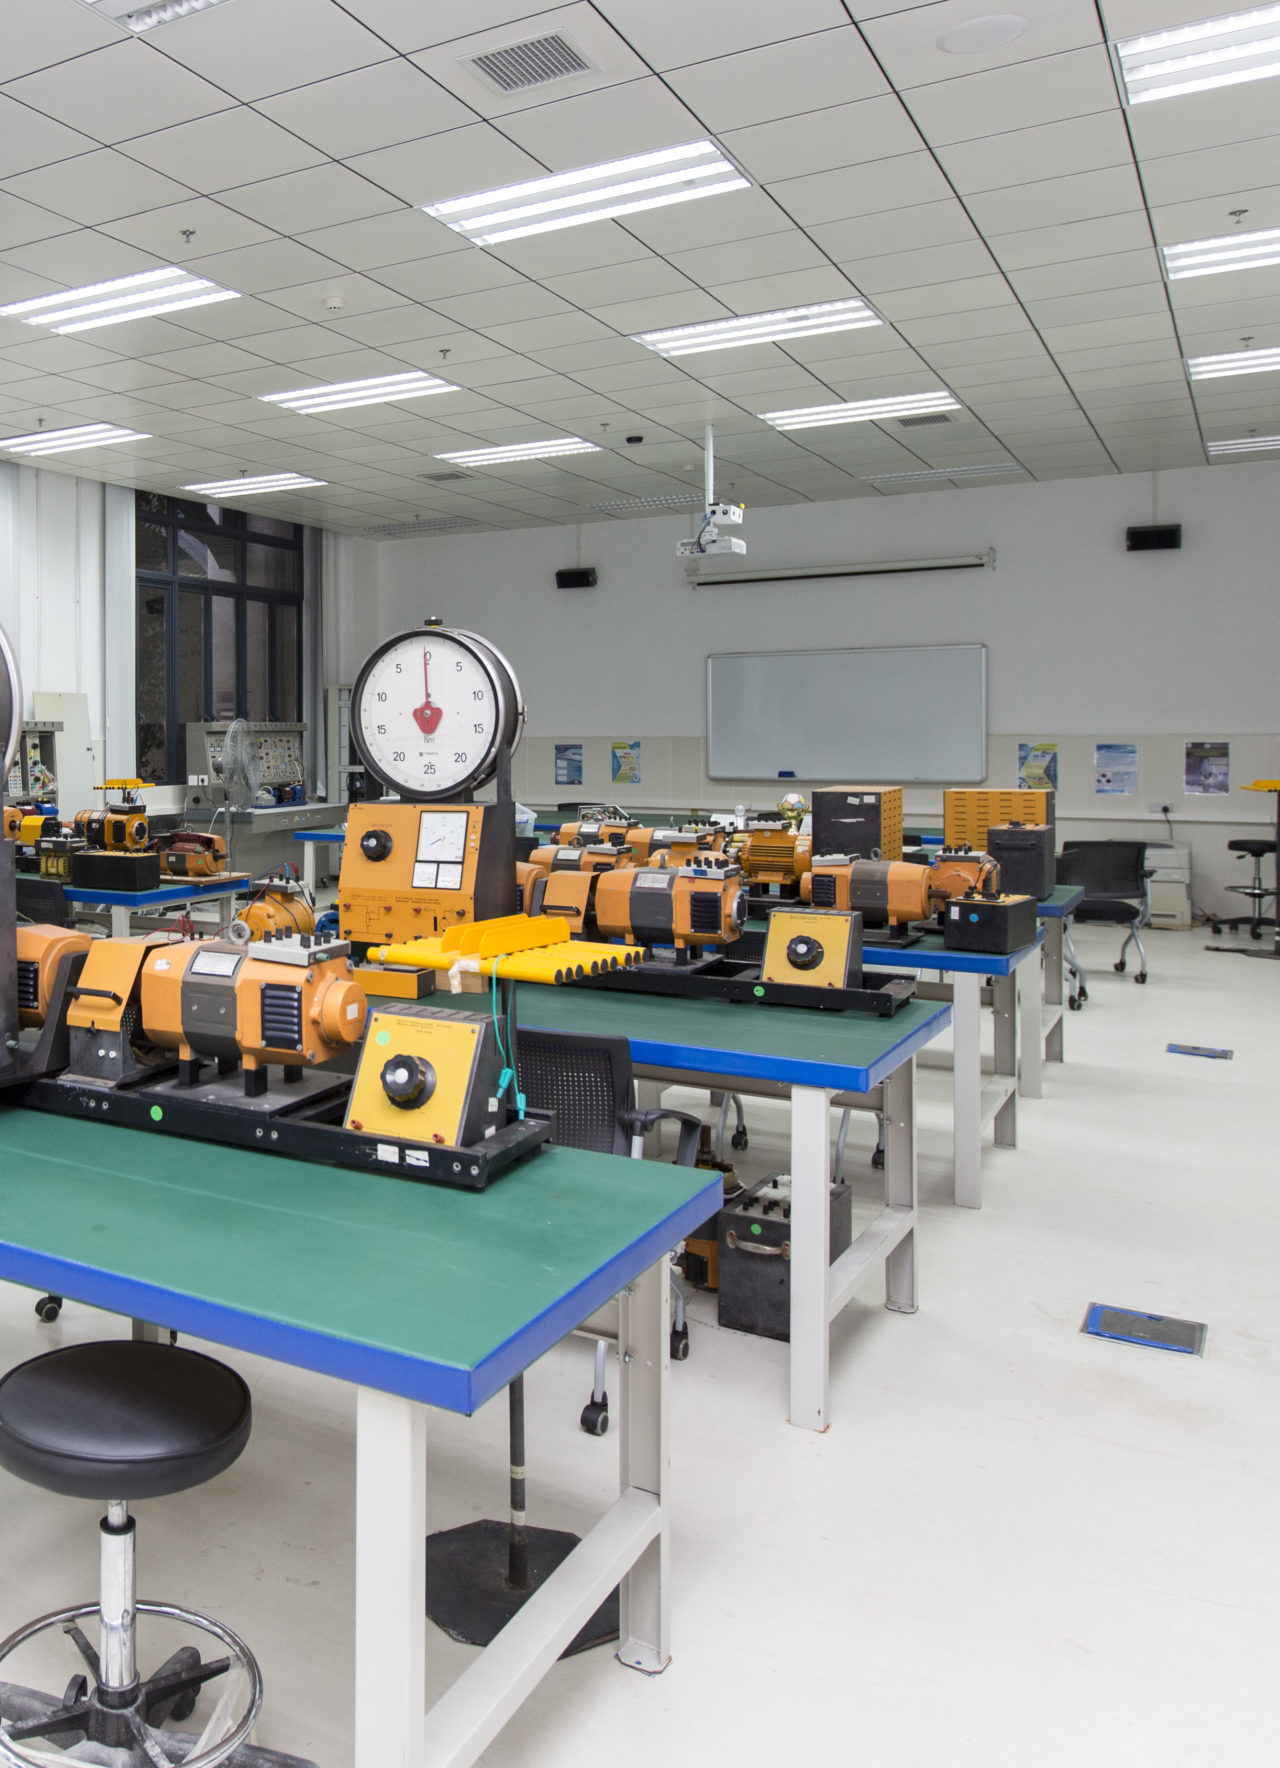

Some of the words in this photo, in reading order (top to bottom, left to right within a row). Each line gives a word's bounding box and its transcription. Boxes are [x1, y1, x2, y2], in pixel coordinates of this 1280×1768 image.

[425, 651, 432, 661] 0
[395, 664, 402, 674] 5
[455, 662, 462, 672] 5
[377, 692, 388, 702] 10
[472, 691, 484, 701] 10
[376, 725, 387, 735] 15
[473, 724, 484, 734] 15
[392, 751, 406, 762] 20
[454, 752, 468, 763] 20
[423, 765, 436, 775] 25
